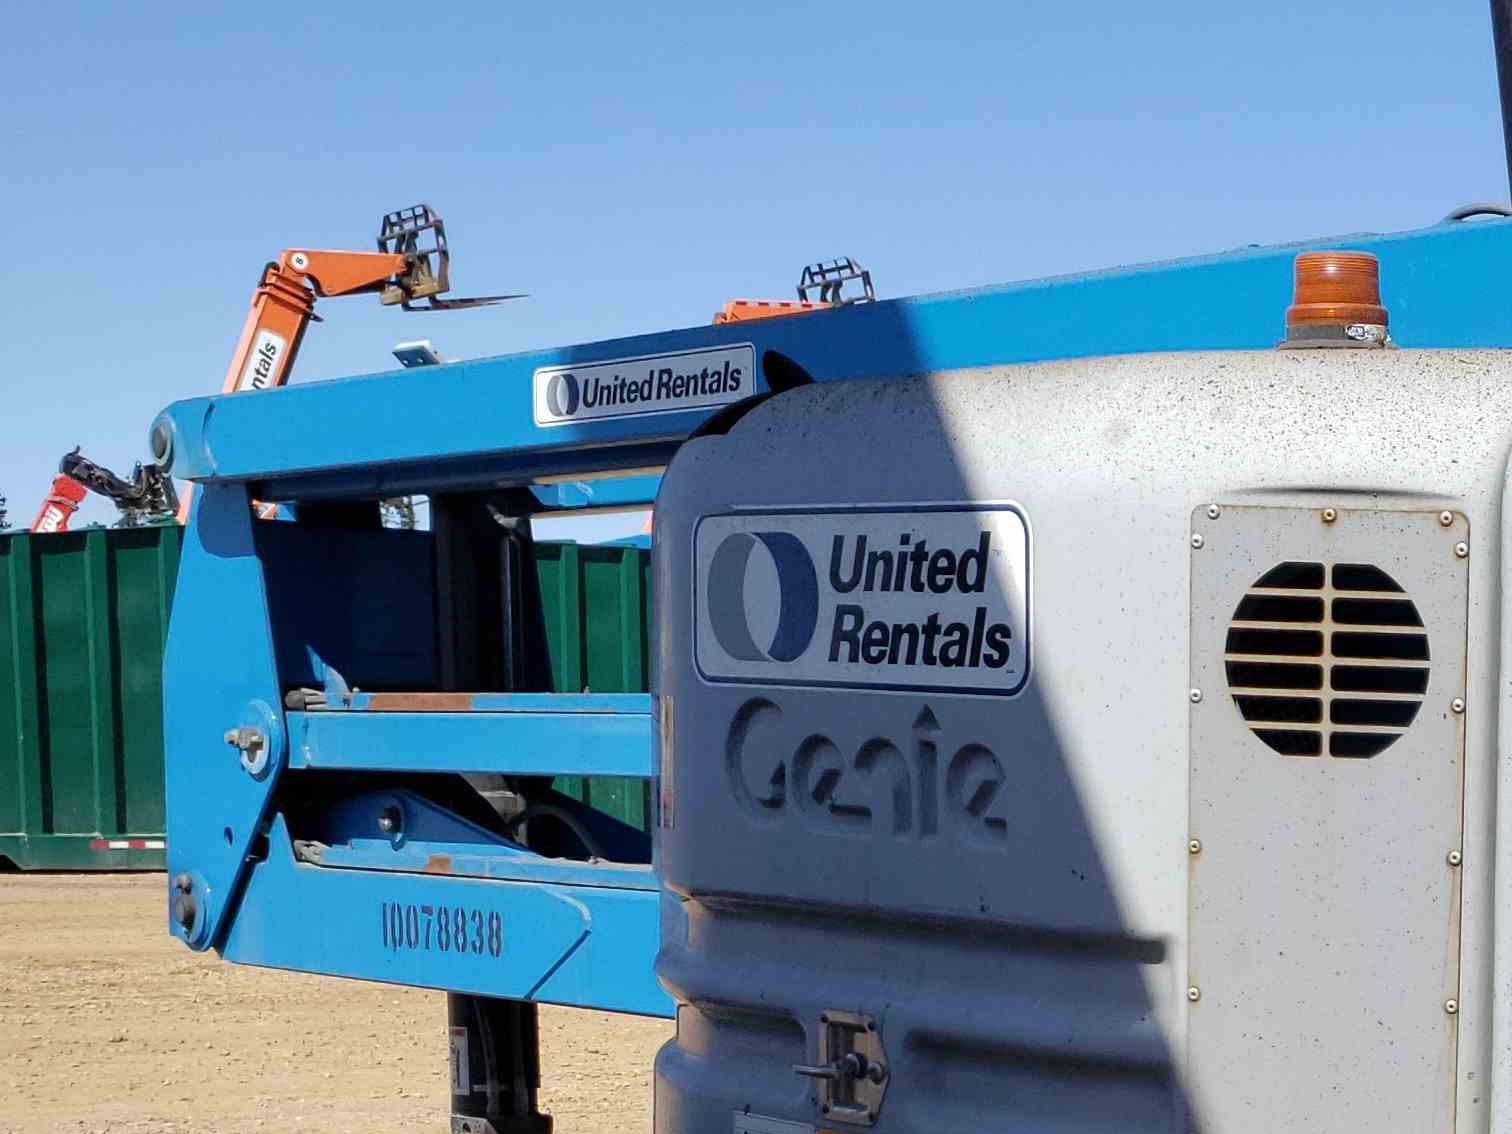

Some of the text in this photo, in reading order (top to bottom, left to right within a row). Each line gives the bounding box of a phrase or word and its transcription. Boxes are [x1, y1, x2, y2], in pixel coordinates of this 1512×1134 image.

[582, 361, 742, 408] United Rentals
[828, 531, 1012, 669] United Rentals
[725, 697, 1008, 836] Genie
